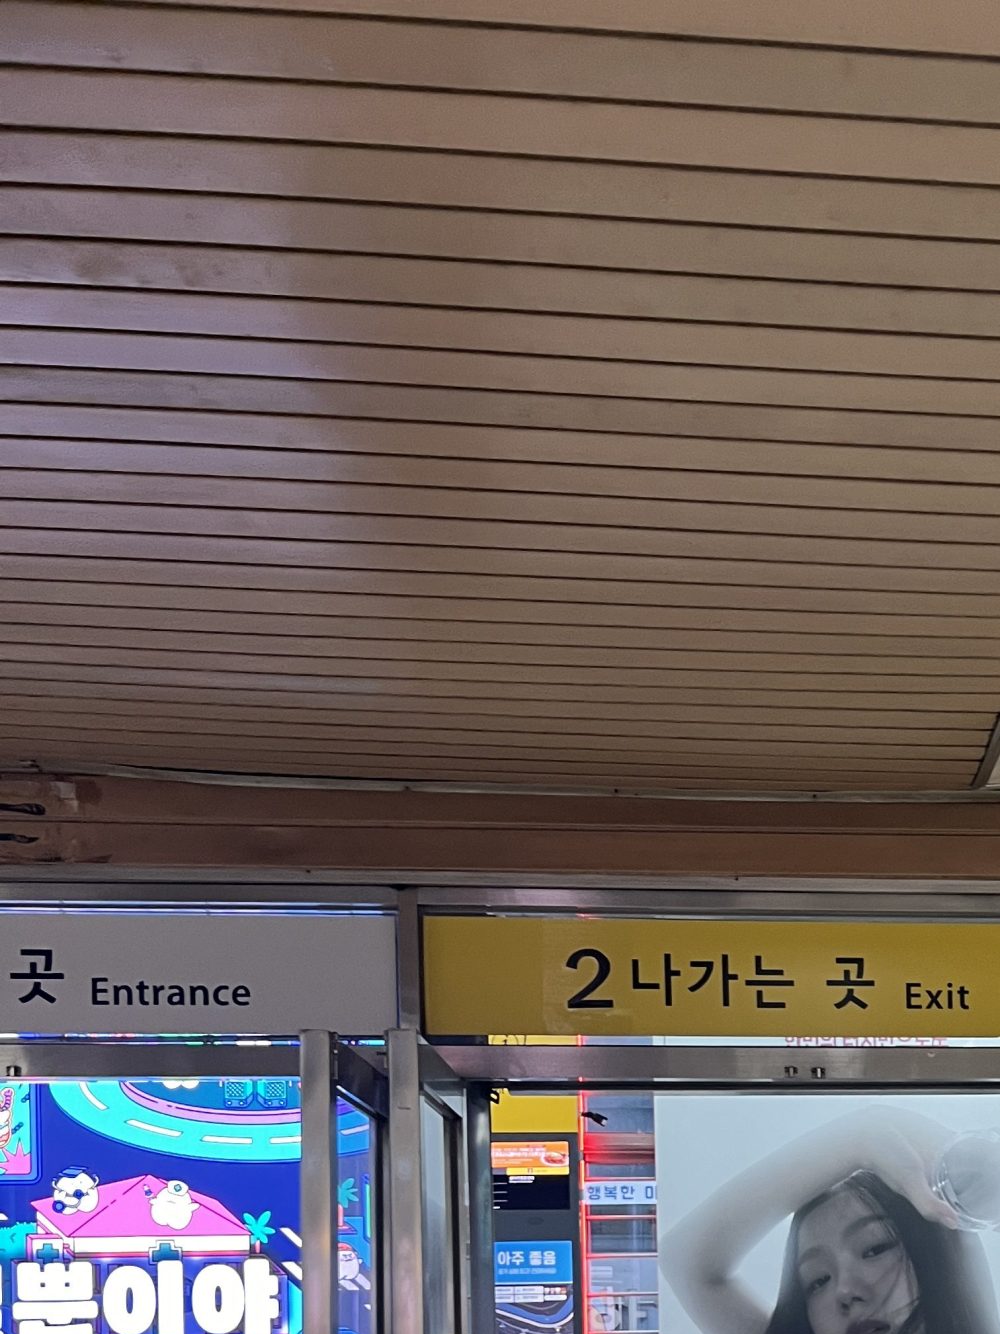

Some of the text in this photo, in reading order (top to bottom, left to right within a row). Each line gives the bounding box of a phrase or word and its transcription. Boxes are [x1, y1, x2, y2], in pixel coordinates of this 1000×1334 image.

[10, 949, 64, 1004] 곳
[565, 947, 875, 1010] 2 나가는 곳
[91, 977, 251, 1006] Entrance
[906, 982, 969, 1010] Exit
[587, 1185, 635, 1200] 행복한
[497, 1251, 525, 1266] 아주
